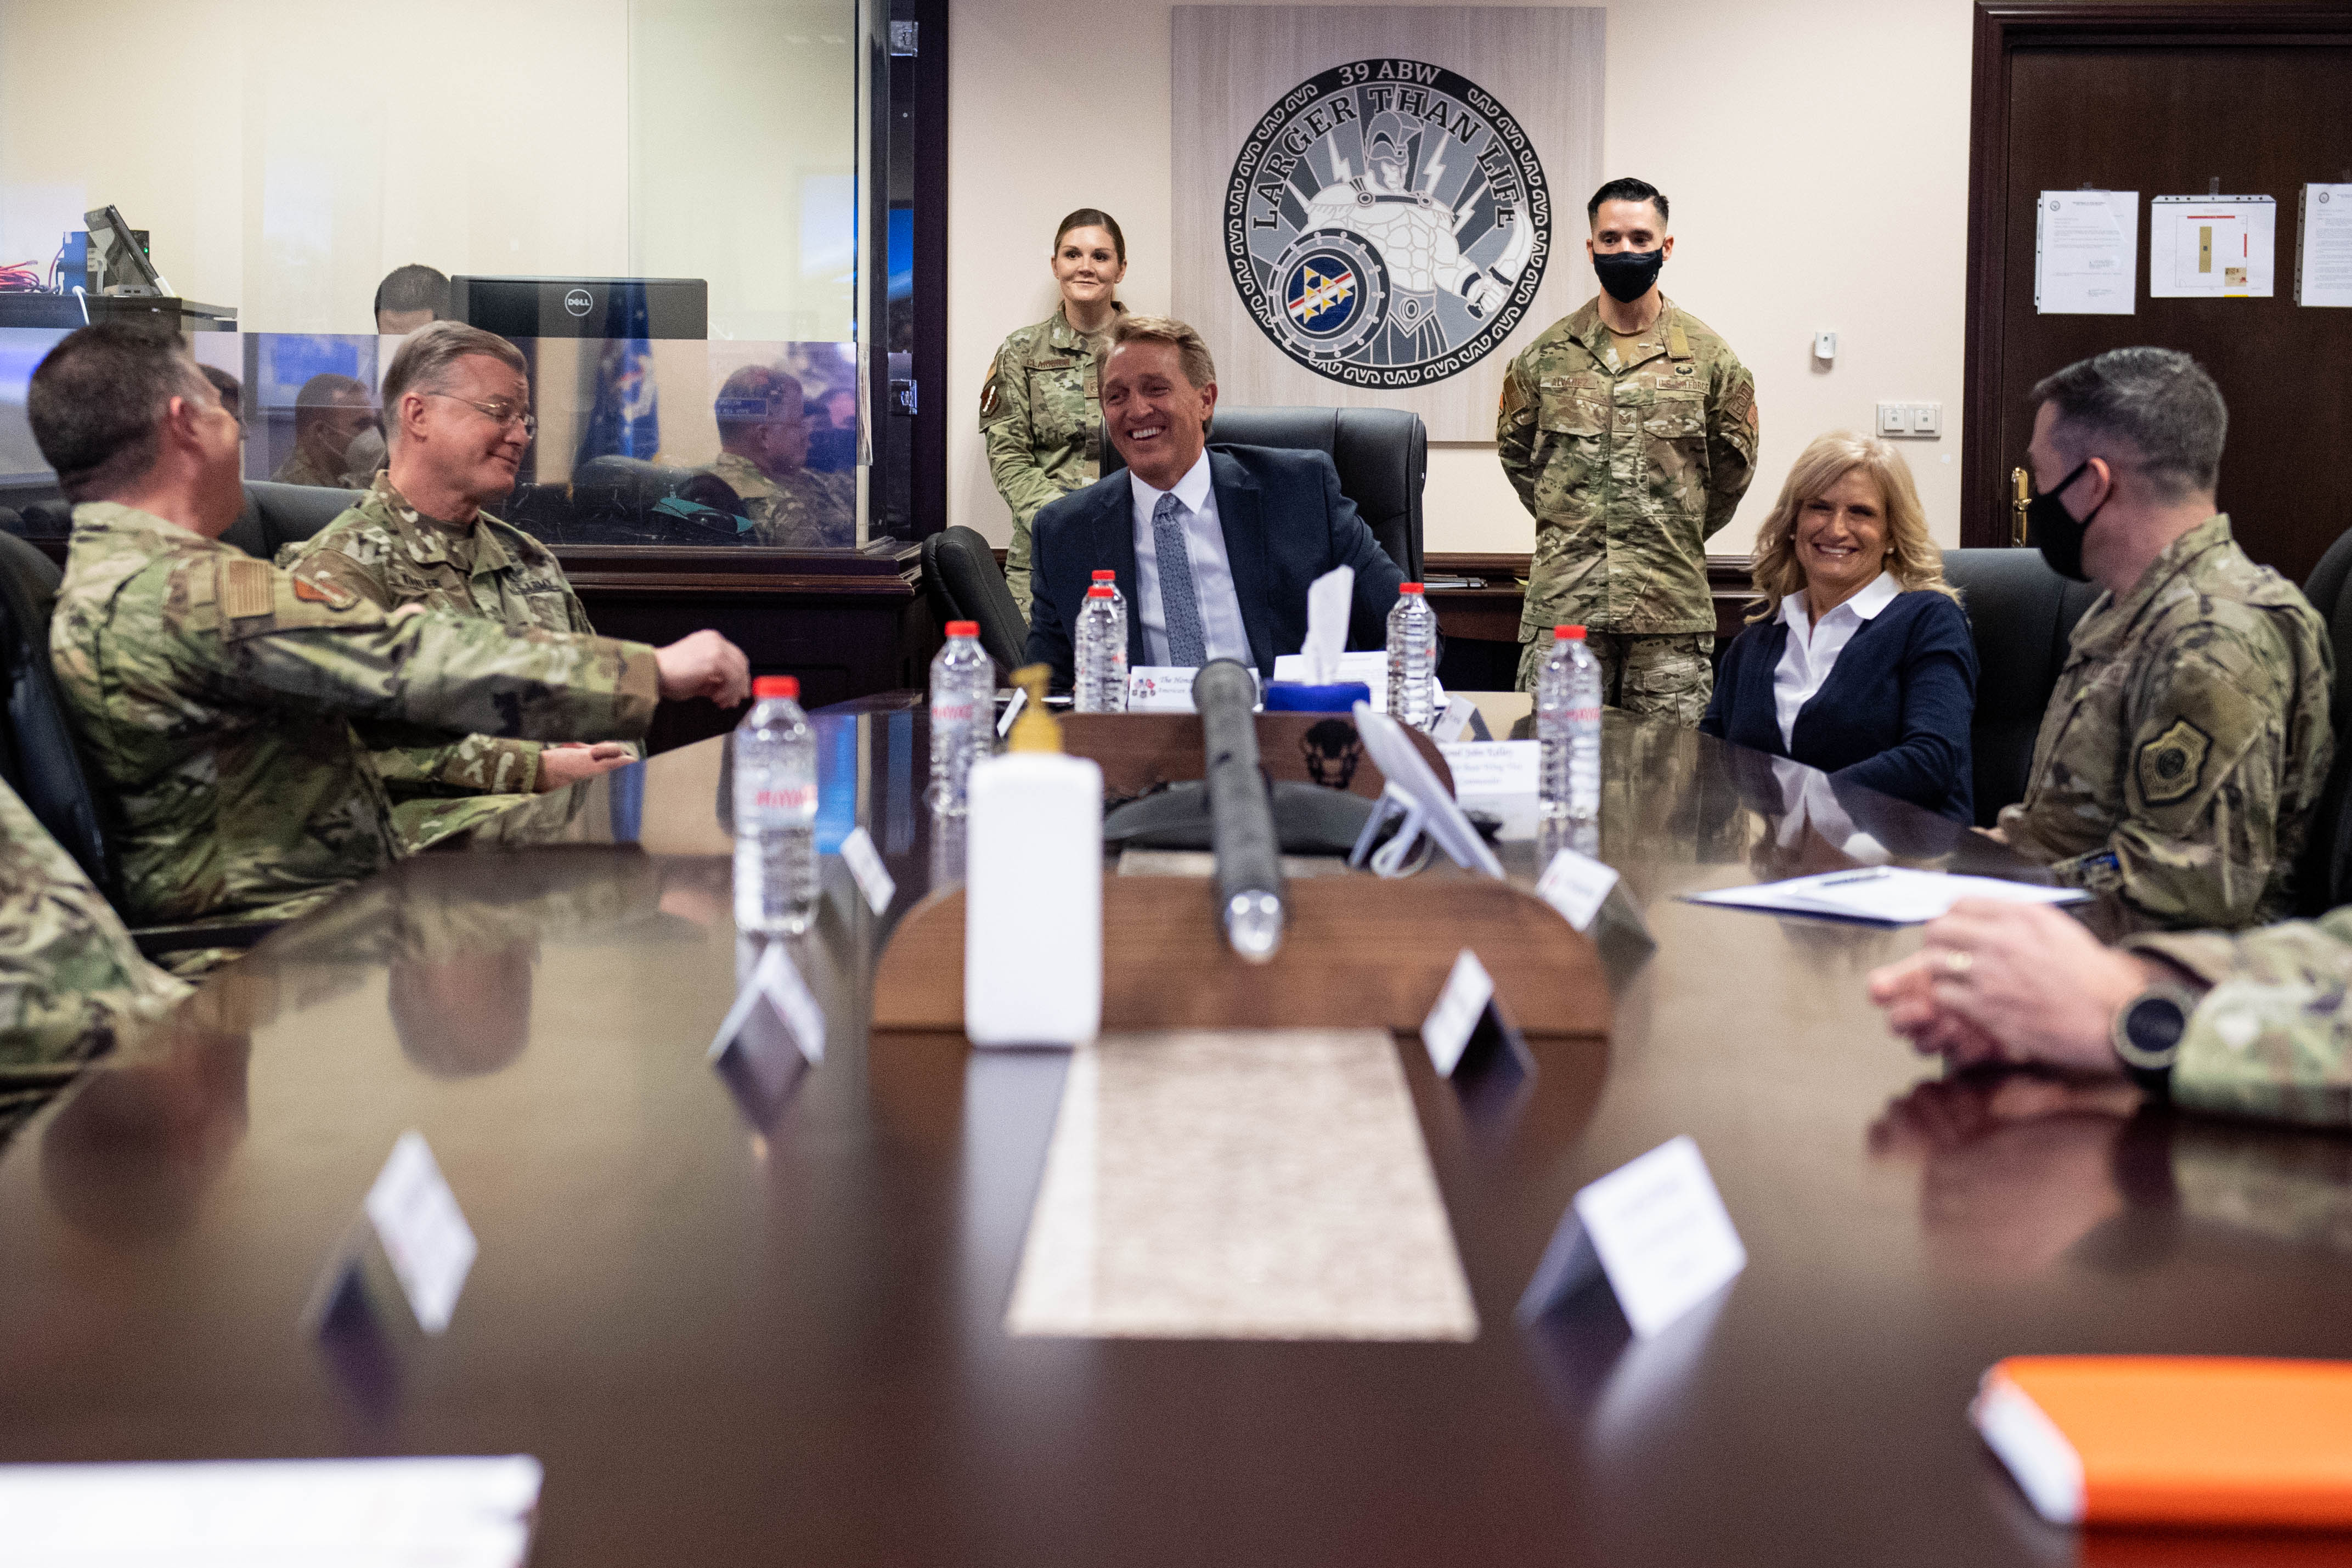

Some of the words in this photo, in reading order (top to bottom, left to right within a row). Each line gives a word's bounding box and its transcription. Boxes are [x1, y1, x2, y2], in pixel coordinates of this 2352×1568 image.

[1339, 62, 1370, 86] 39
[1377, 60, 1441, 86] ABW
[1253, 95, 1357, 231] LARGER
[1367, 87, 1482, 146] THAN
[1475, 141, 1524, 229] LIFE
[567, 298, 590, 306] DELL
[1552, 376, 1590, 387] ALVAREZ
[1689, 381, 1709, 393] FORCE
[1731, 386, 1752, 416] EOD
